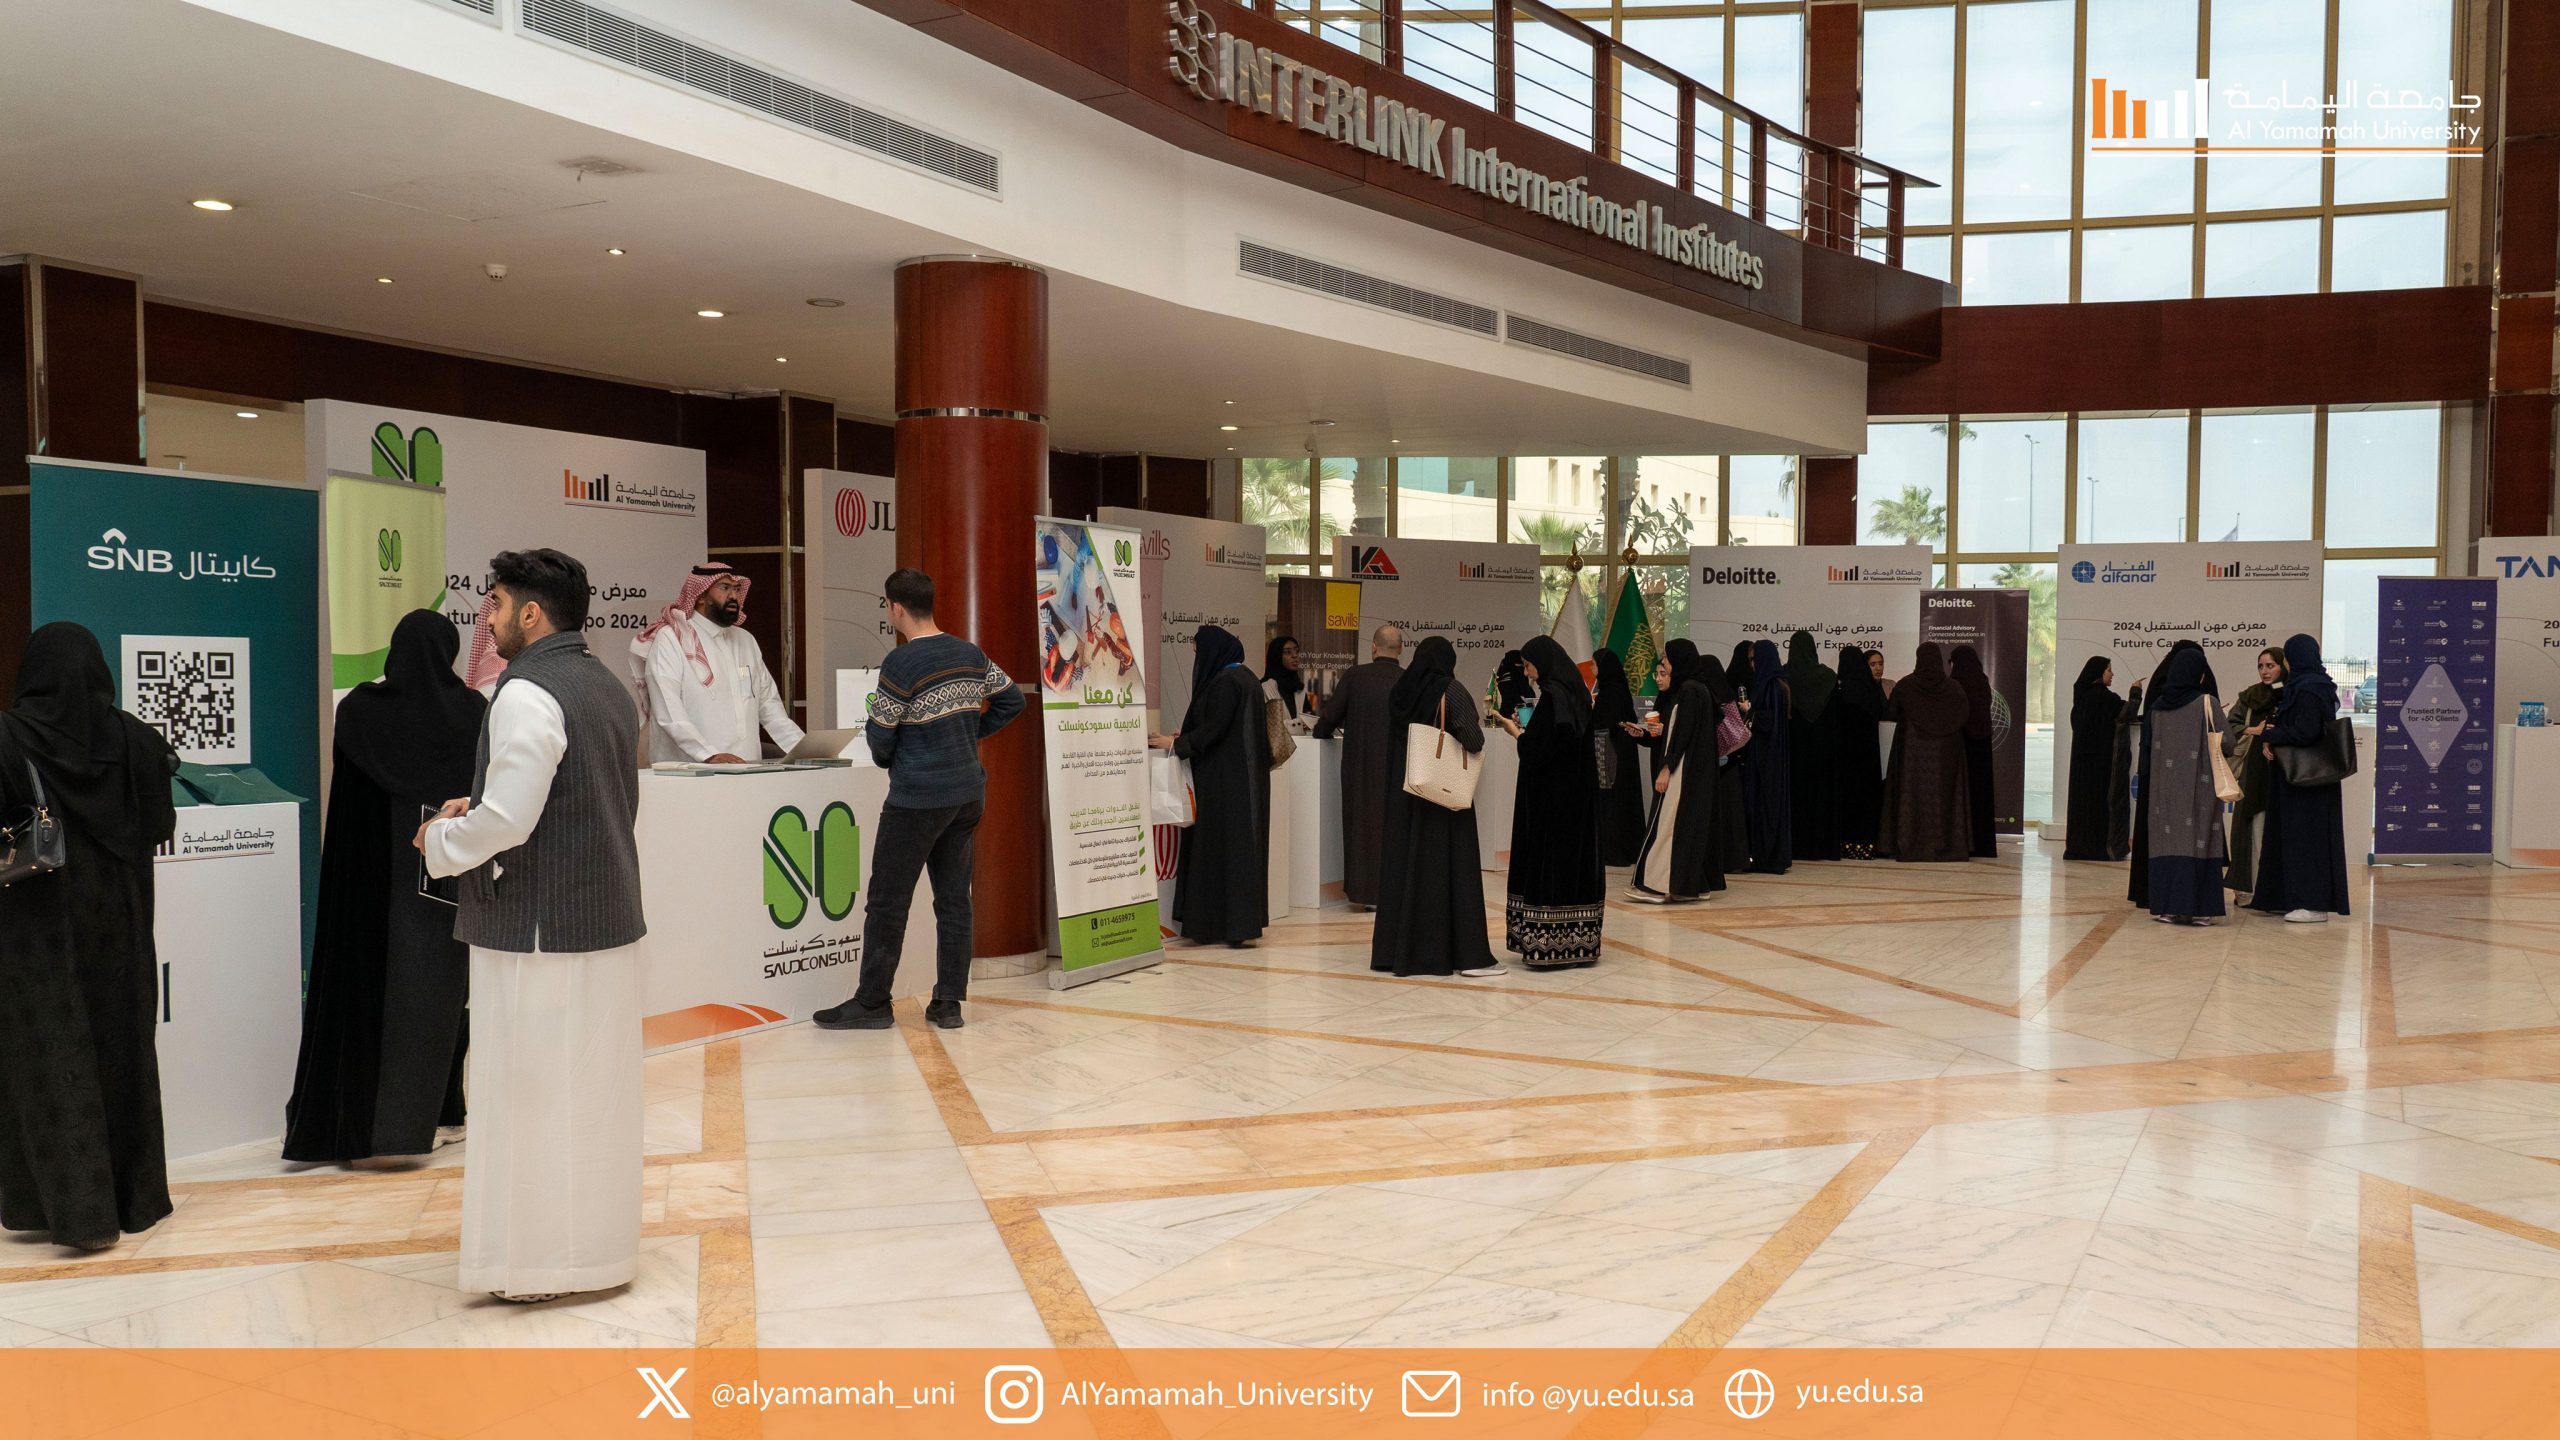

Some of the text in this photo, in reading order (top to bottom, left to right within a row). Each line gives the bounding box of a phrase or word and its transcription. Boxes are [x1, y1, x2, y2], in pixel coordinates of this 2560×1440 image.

[1218, 32, 1764, 290] INTERLINK International Institutes
[616, 481, 695, 502] جامعة اليمامة
[626, 497, 660, 507] Yamamah
[663, 501, 695, 512] University
[868, 501, 896, 531] JL
[1140, 530, 1171, 561] vills
[87, 545, 276, 582] SNB كابيتال
[1703, 566, 1781, 585] Deloitte.
[2101, 570, 2156, 583] alfanar
[602, 583, 647, 600] معرض
[585, 616, 605, 632] po
[611, 614, 648, 629] 2024
[1168, 611, 1203, 624] المستقبل
[1327, 613, 1358, 629] savills
[1412, 620, 1456, 632] المستقبل
[1458, 621, 1476, 634] مهن
[1478, 622, 1505, 632] معرض
[1742, 624, 1768, 632] 2024
[1826, 622, 1848, 635] مهن
[1851, 623, 1883, 635] معرض
[2113, 620, 2267, 633] معرض مهن المستقبل 2024
[1457, 639, 1480, 650] Expo
[1483, 640, 1504, 648] 2024
[1857, 641, 1883, 649] 2024
[2113, 639, 2153, 648] Future
[2202, 638, 2233, 649] Expo
[2237, 639, 2267, 647] 2024
[1083, 682, 1133, 708] كن معنا
[182, 828, 274, 843] جامعة اليمامة
[183, 840, 275, 854] Al Yamamah University
[764, 948, 860, 979] SAUDCONSULT
